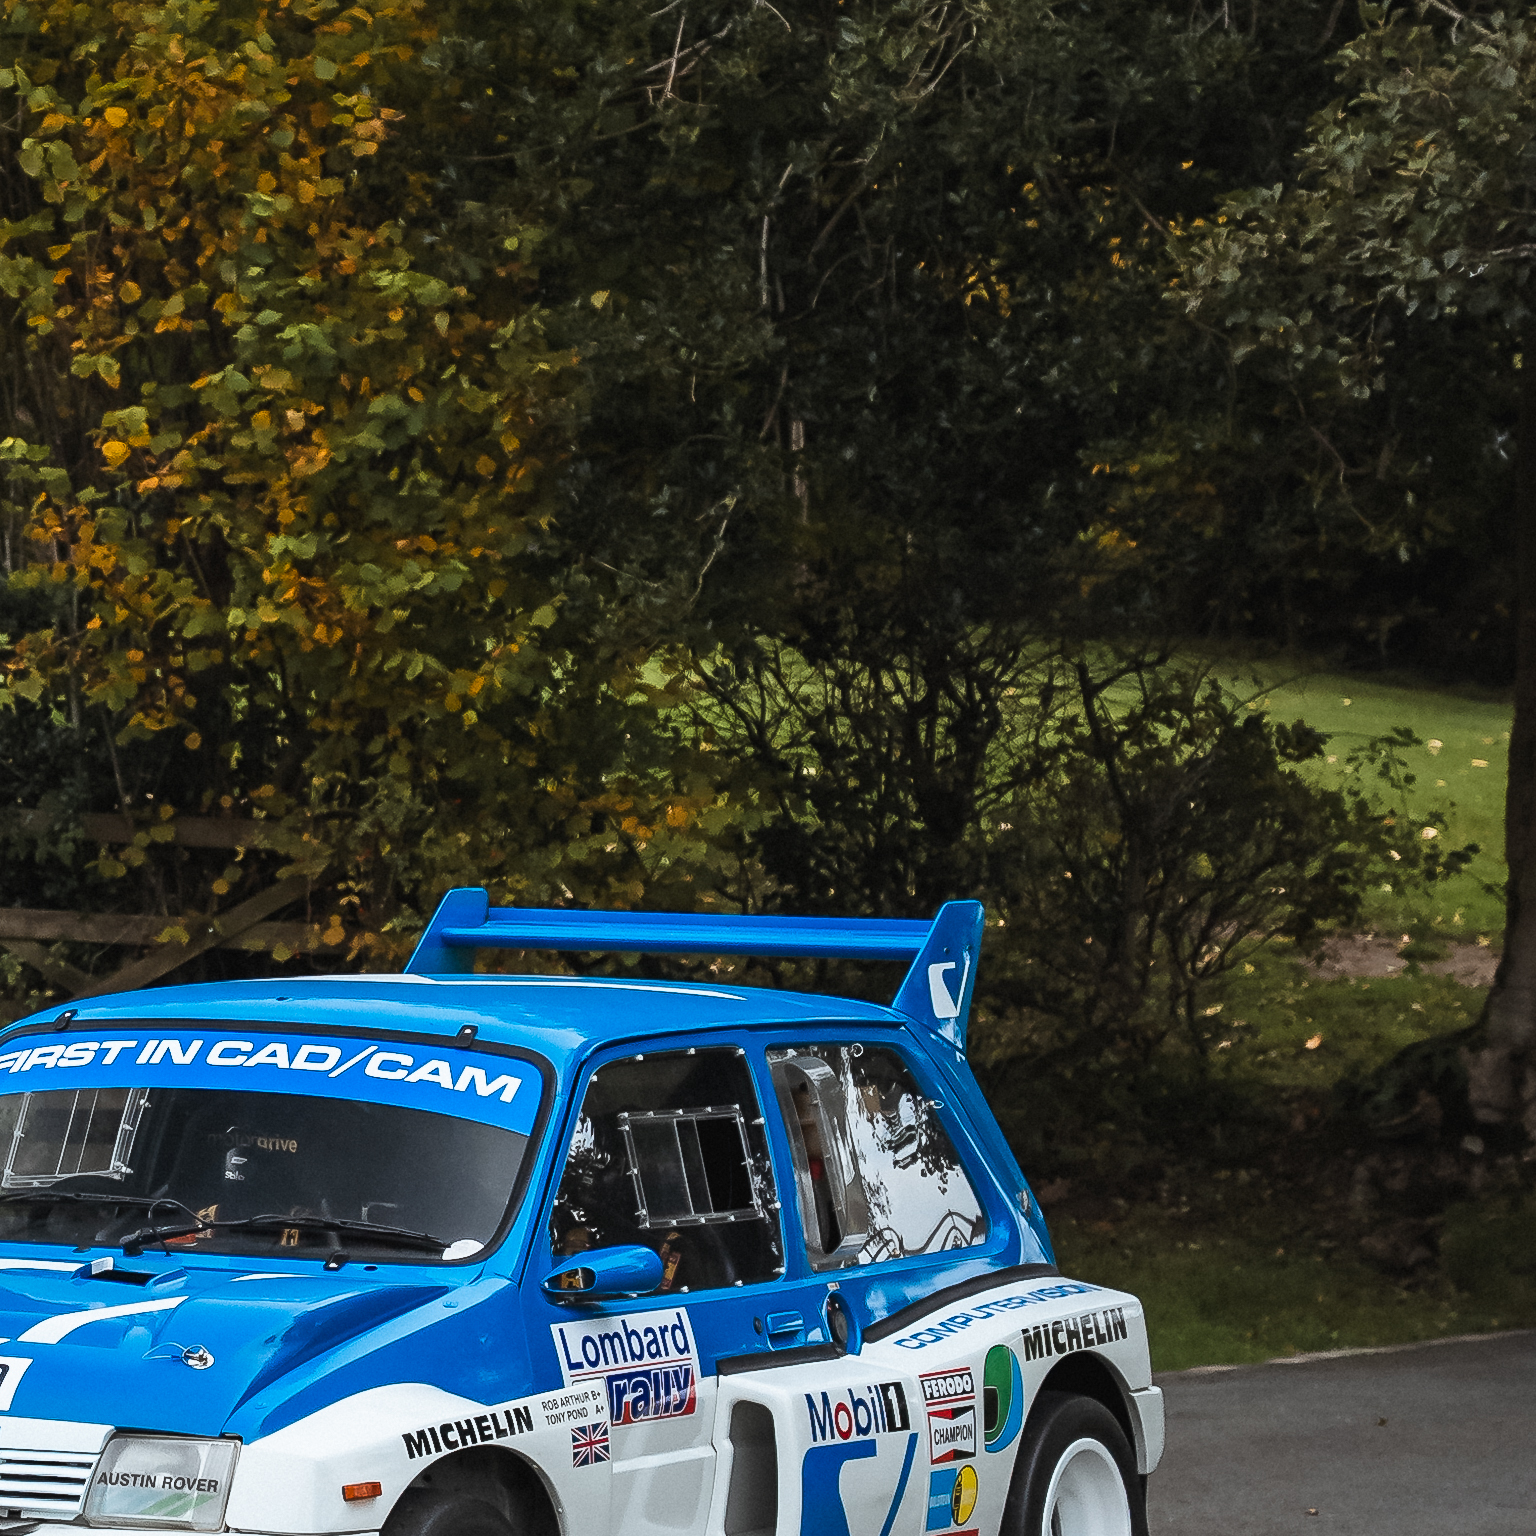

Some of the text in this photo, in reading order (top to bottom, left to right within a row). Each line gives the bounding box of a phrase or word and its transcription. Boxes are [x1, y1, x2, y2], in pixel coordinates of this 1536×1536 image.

[138, 1039, 191, 1066] IN
[206, 1040, 522, 1104] CAD/CAM
[558, 1312, 691, 1371] Lombard
[893, 1284, 1102, 1350] COMPUTERVISION
[1021, 1307, 1128, 1362] MICHELIN
[541, 1398, 559, 1412] ROB
[560, 1392, 591, 1409] ARTHUR
[612, 1366, 695, 1423] rally
[922, 1374, 972, 1399] FERODO
[401, 1405, 534, 1459] MICHELIN
[545, 1411, 566, 1426] TONY
[566, 1406, 589, 1422] POND
[934, 1423, 973, 1446] CHAMPION
[97, 1471, 219, 1493] AUSTIN ROVER
